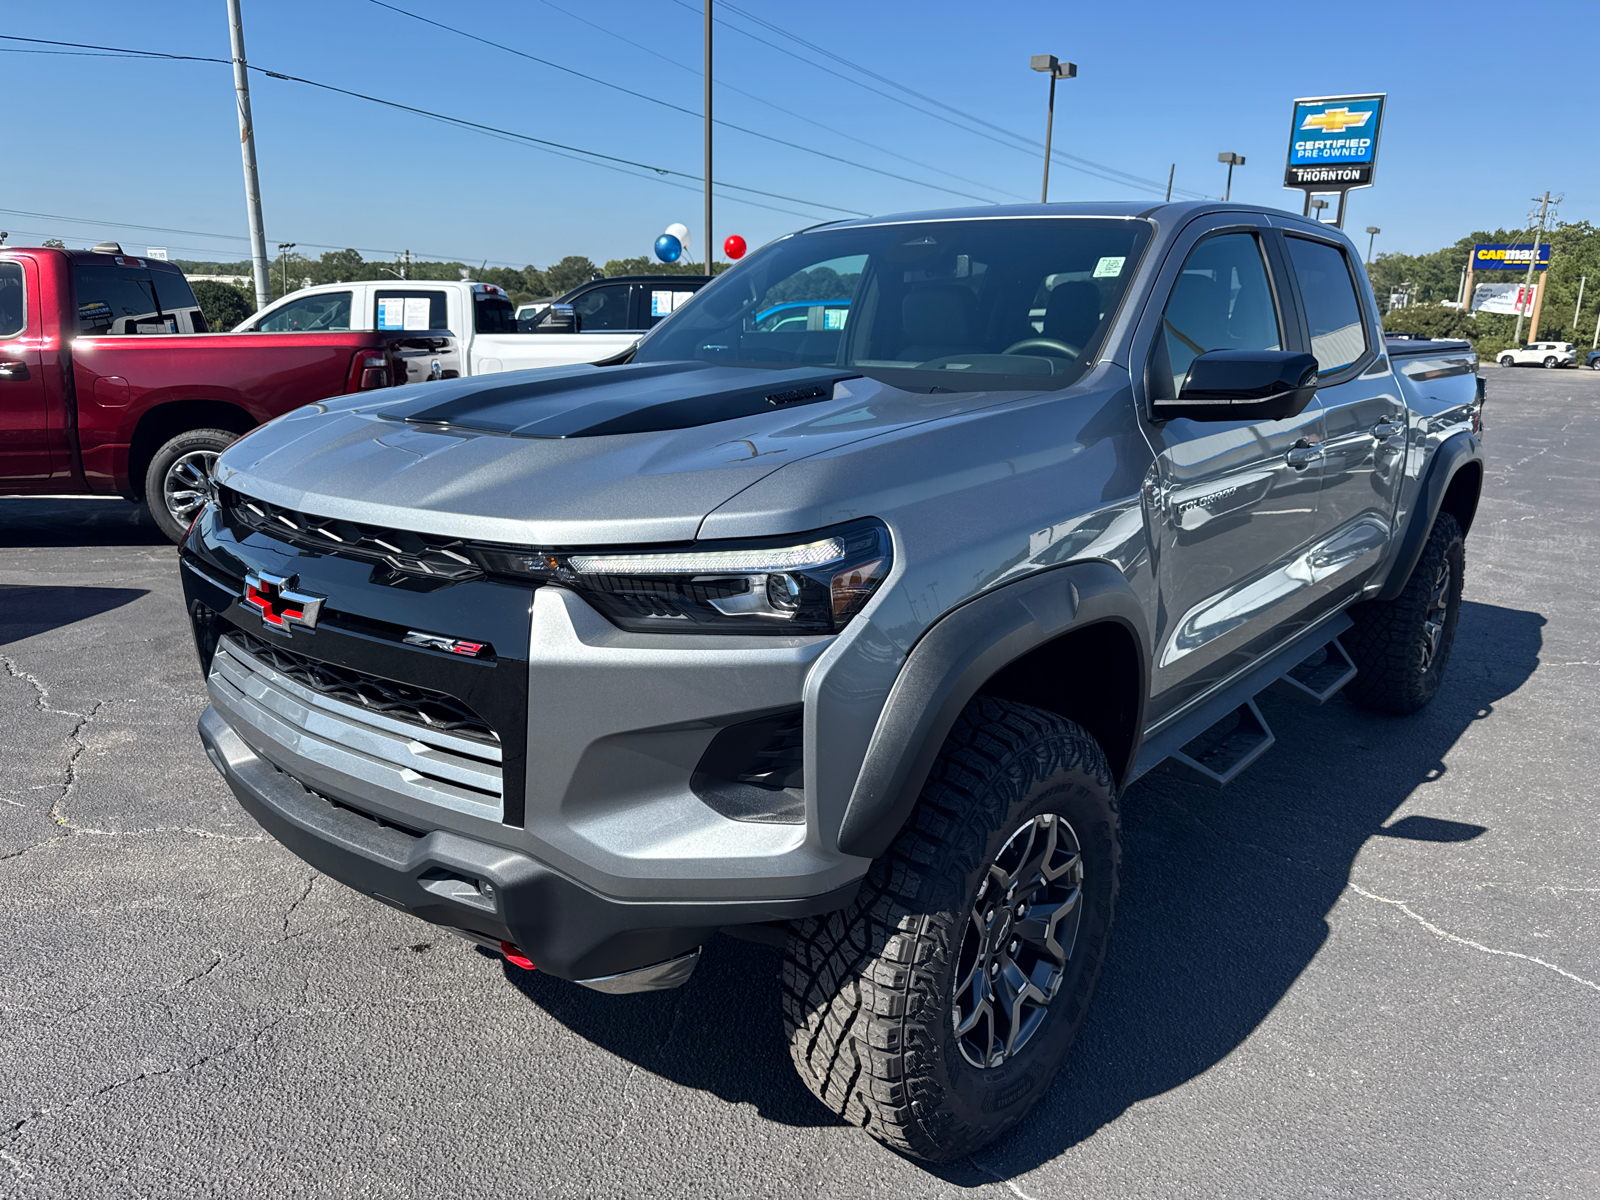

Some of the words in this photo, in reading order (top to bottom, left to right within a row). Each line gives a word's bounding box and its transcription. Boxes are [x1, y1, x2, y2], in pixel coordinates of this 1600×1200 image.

[1295, 139, 1370, 150] CERTIFIED
[1297, 148, 1365, 158] PRE-OWNED
[1297, 170, 1360, 181] THORNTON
[1177, 486, 1237, 515] COLORADO
[402, 631, 483, 656] ZR2
